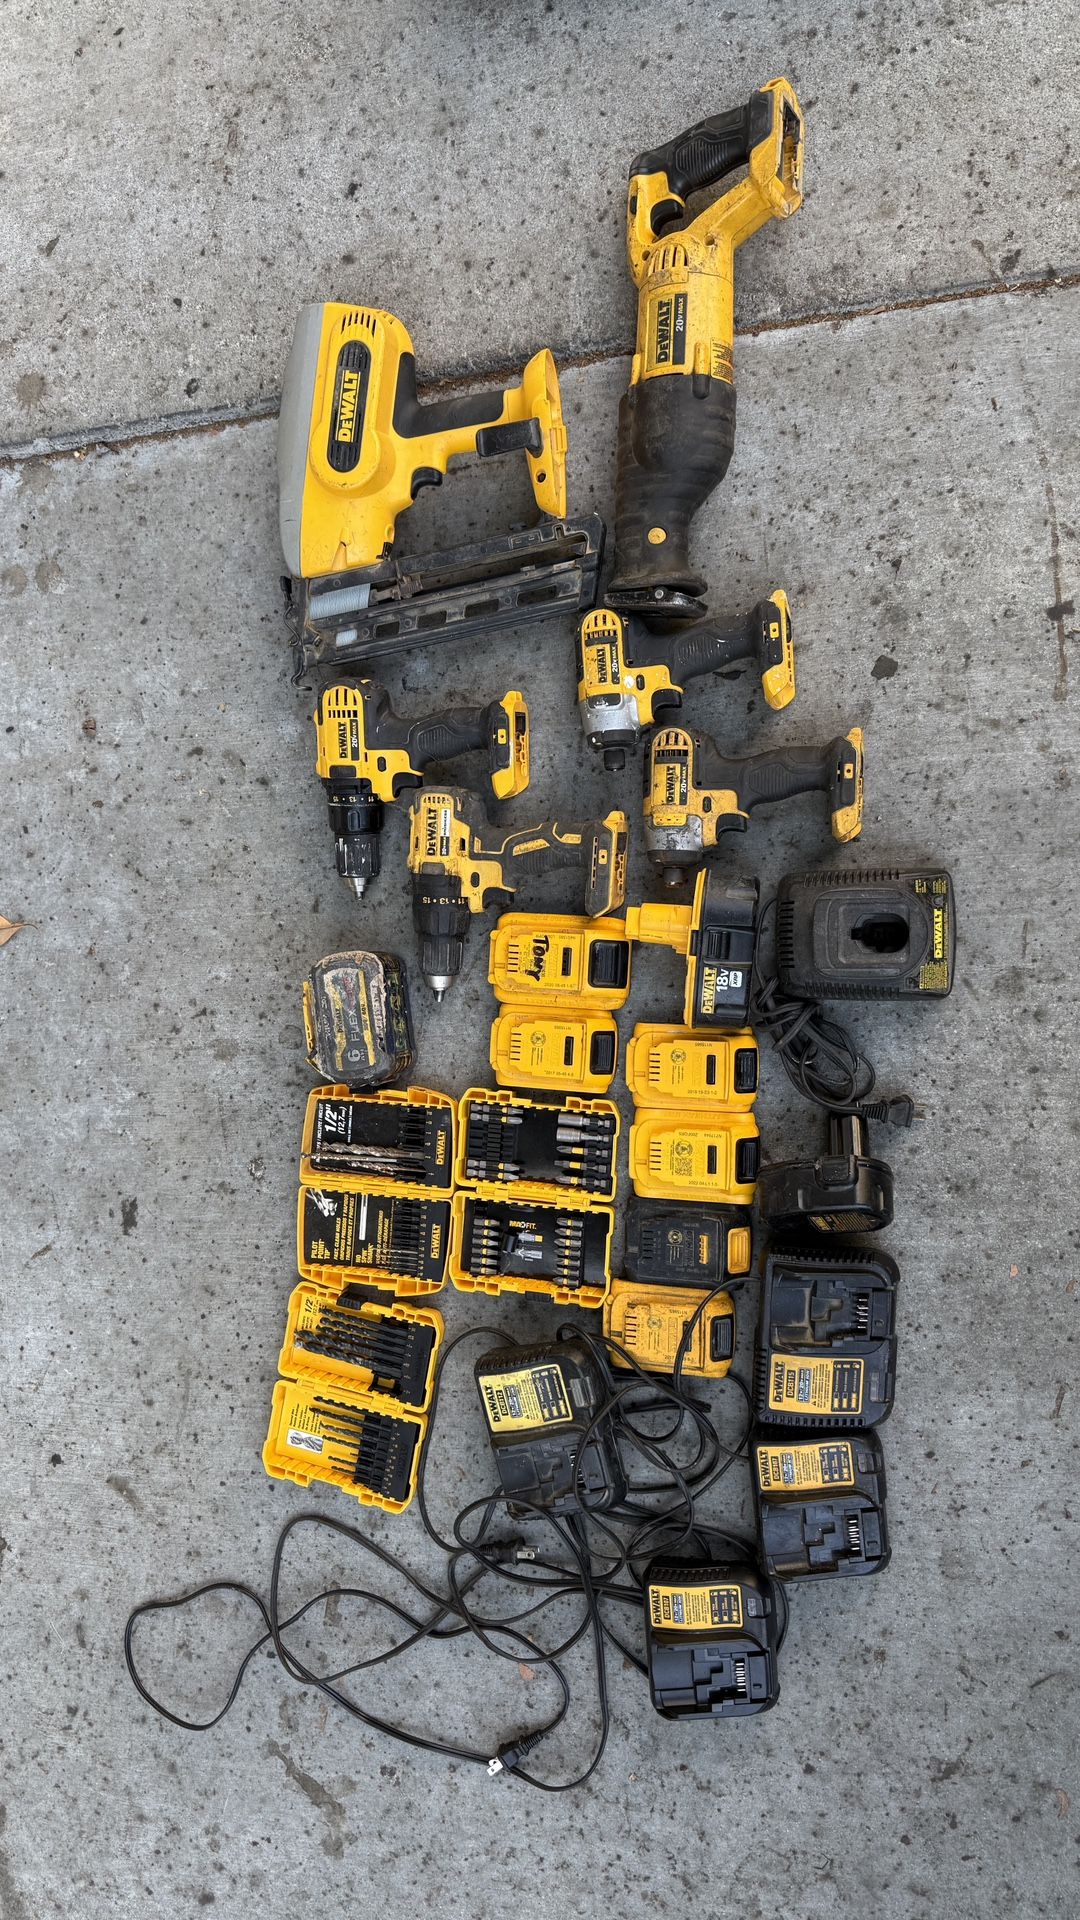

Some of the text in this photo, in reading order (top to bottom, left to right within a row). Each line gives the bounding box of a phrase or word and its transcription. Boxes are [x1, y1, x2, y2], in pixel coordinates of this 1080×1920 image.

[657, 298, 671, 364] DEWALT
[676, 314, 684, 332] 20V
[338, 370, 359, 442] DEWALT
[597, 648, 607, 683] DEWALT
[338, 722, 348, 758] DEWALT
[666, 765, 676, 803] DEWALT
[428, 808, 438, 856] DEWALT
[934, 908, 942, 958] DEWALT
[702, 967, 716, 1014] DEWALT
[716, 968, 729, 992] 18V
[347, 1048, 361, 1063] 6
[436, 1130, 446, 1165] DEWALT
[310, 1240, 318, 1259] PILOT
[431, 1224, 441, 1258] DEWALT
[773, 1361, 785, 1403] DEWALT
[485, 1386, 501, 1422] DEWALT
[760, 1450, 771, 1487] DEWALT
[652, 1589, 662, 1624] DEWALT
